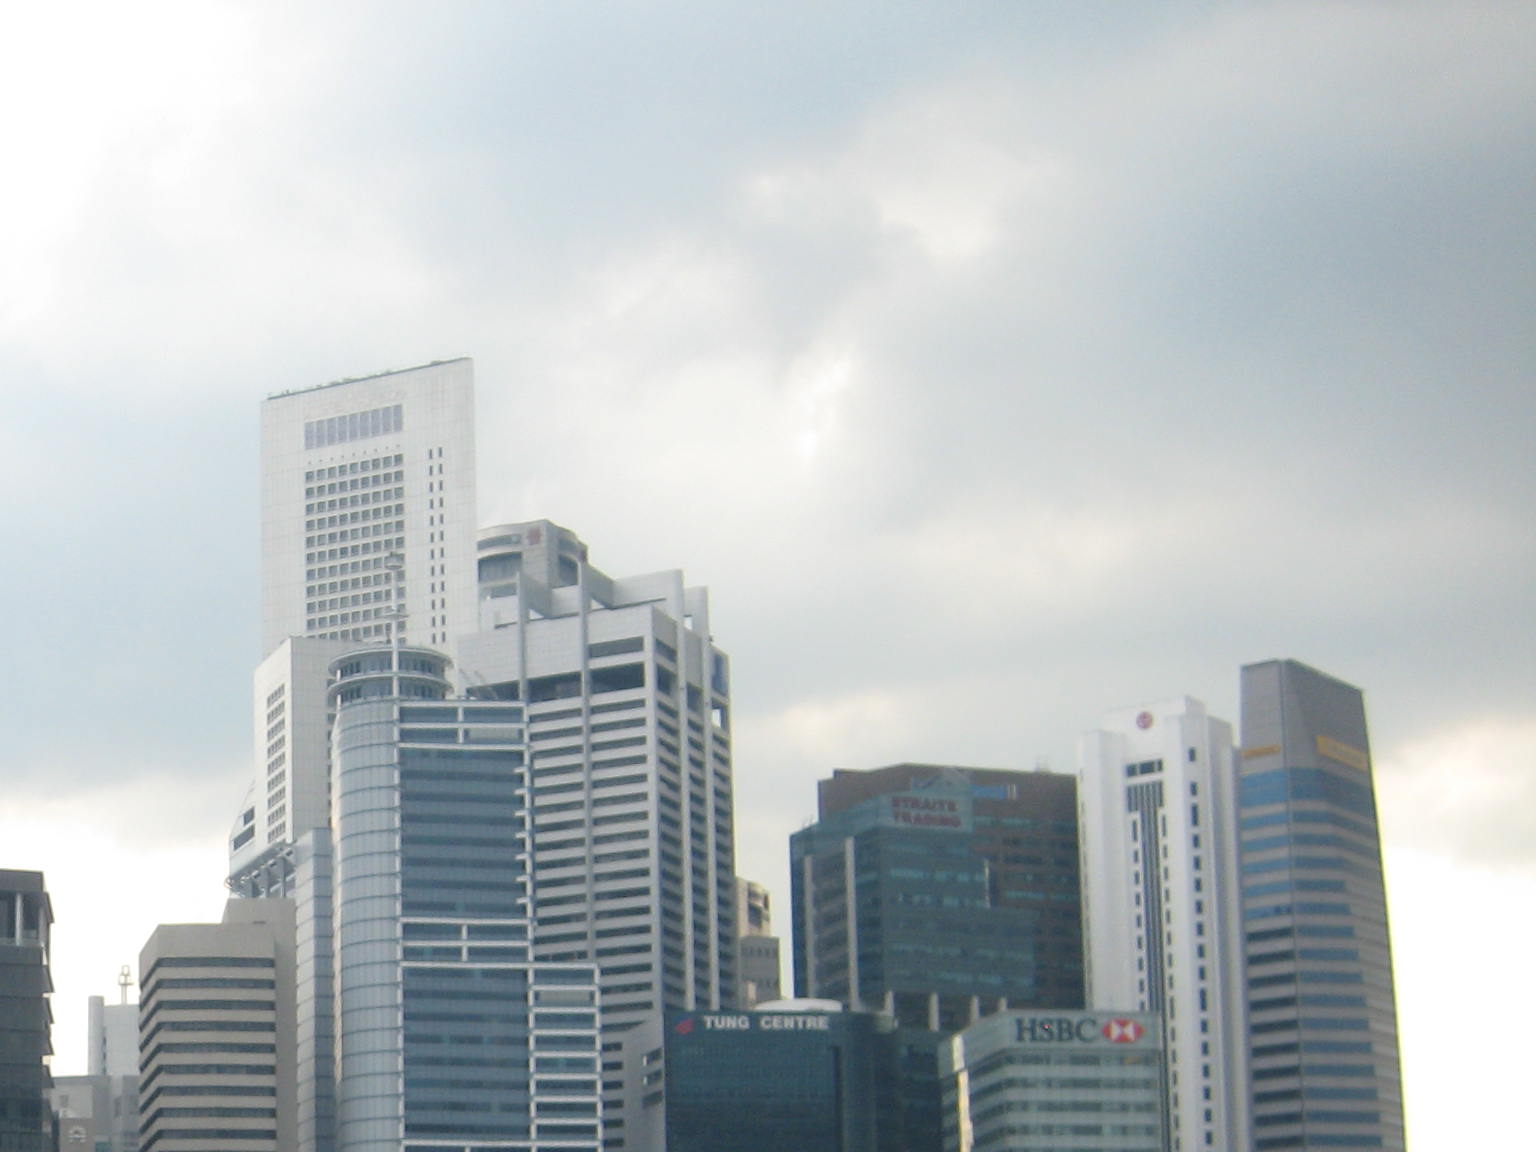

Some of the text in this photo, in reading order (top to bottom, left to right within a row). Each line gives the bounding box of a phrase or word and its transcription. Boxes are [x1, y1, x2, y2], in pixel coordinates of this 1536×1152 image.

[703, 1015, 829, 1030] TUNG CENTRE
[1015, 1017, 1098, 1042] HSBC
